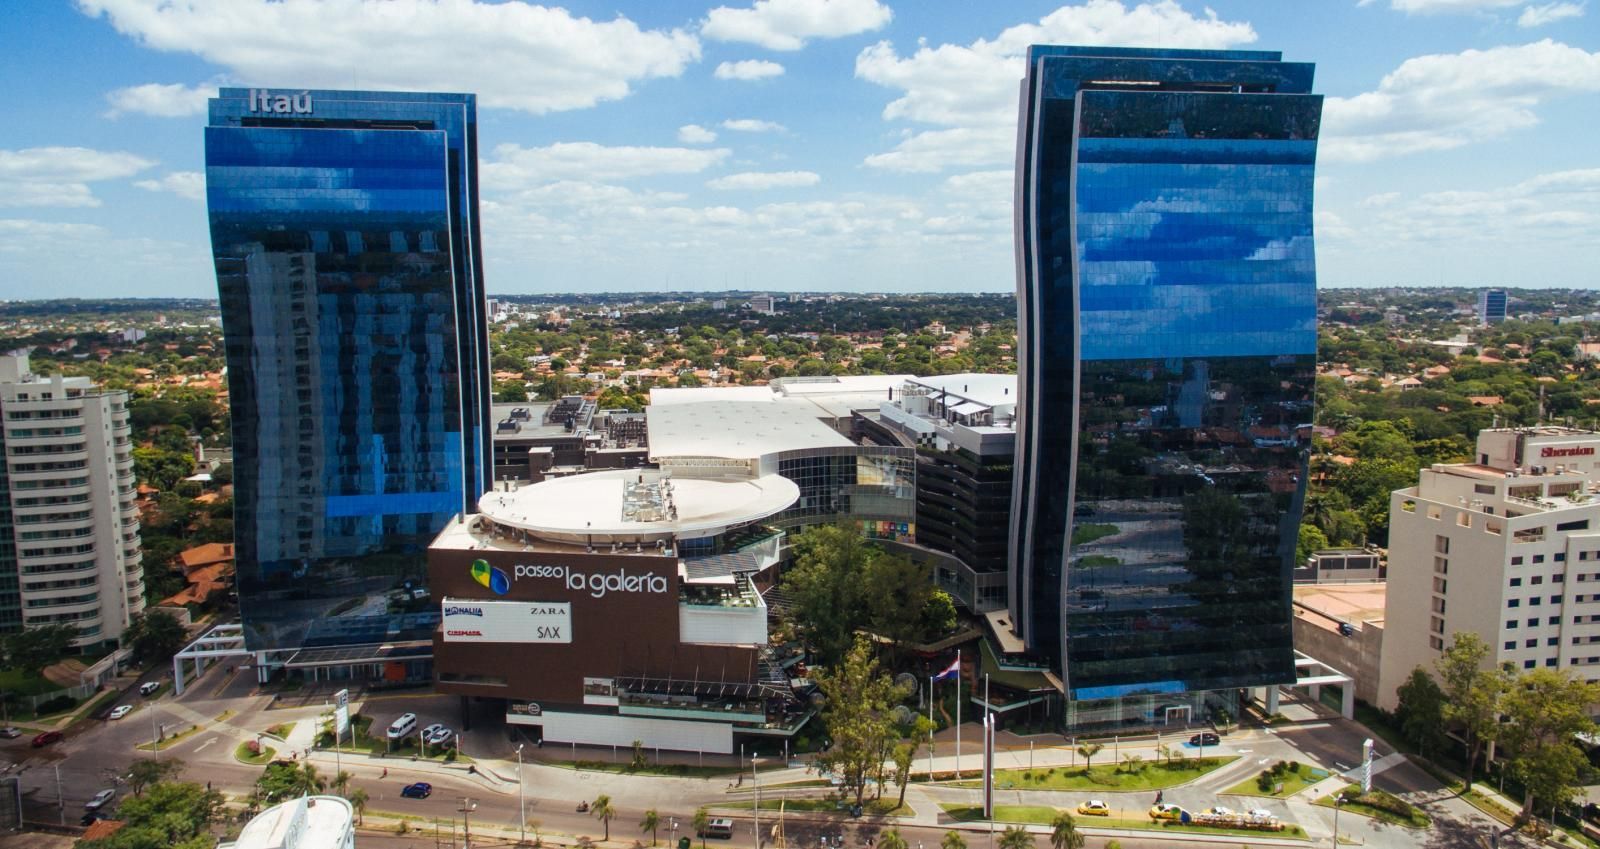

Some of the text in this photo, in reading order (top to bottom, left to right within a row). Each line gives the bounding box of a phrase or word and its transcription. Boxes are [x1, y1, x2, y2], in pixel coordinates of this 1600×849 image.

[249, 88, 313, 113] Itaú
[1541, 446, 1595, 457] Sheraton
[514, 564, 667, 598] paseo la galería
[530, 607, 566, 615] ZARA
[537, 626, 560, 639] SAX
